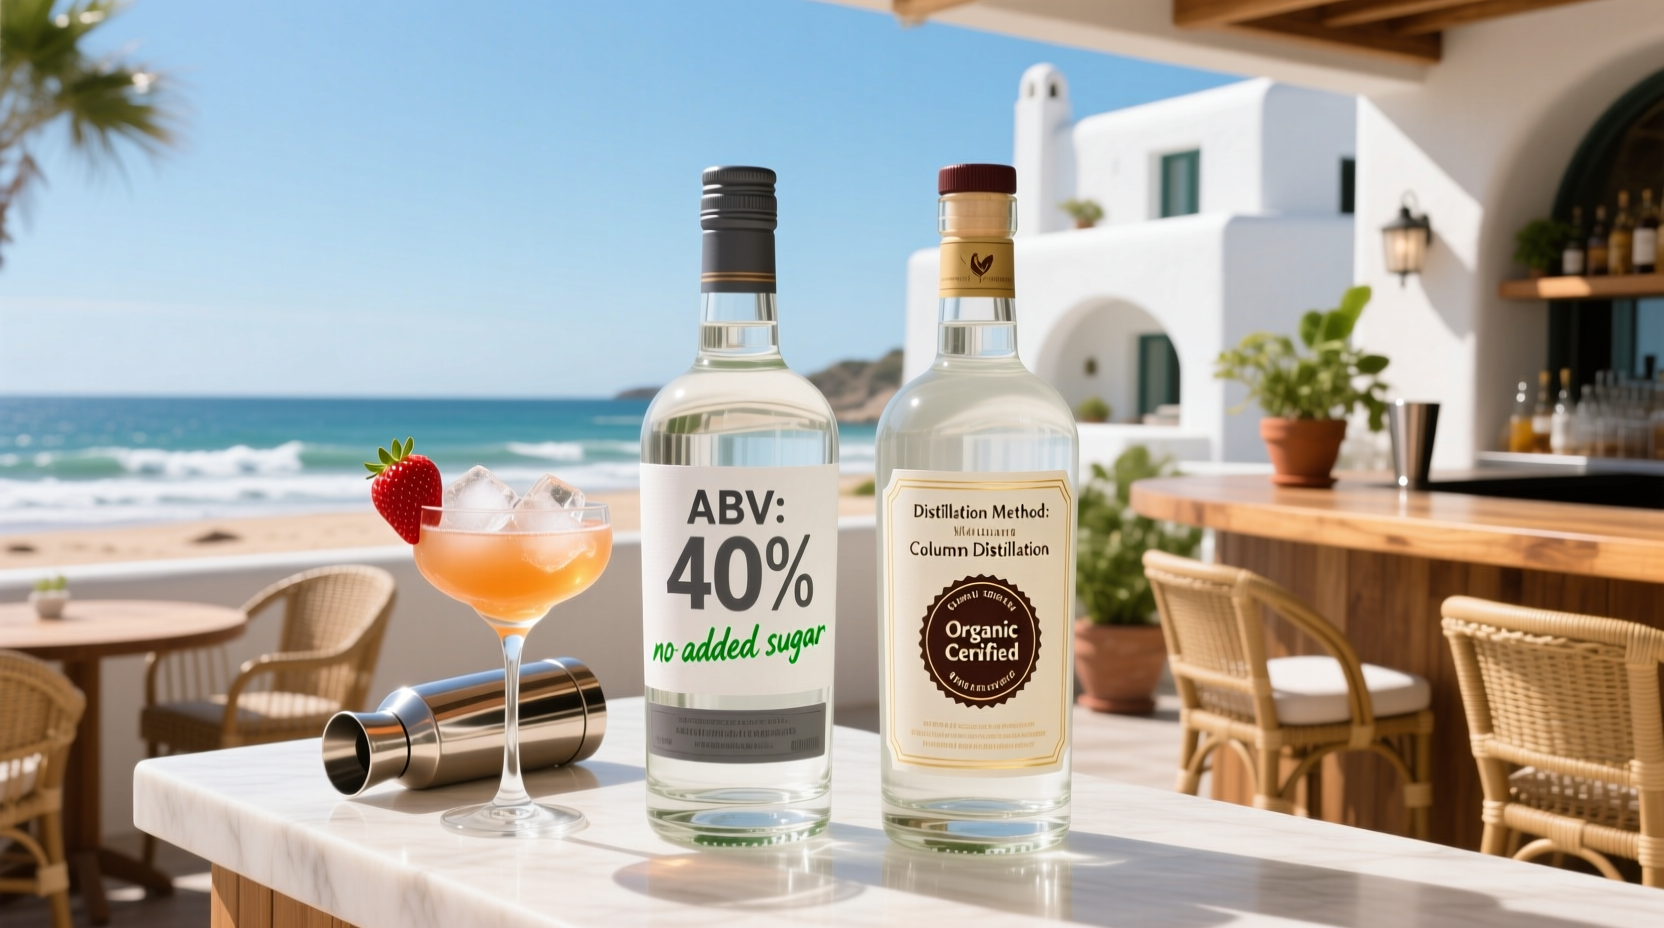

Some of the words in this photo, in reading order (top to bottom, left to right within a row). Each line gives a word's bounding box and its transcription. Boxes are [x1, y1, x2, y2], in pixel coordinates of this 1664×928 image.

[687, 489, 785, 525] ABV:
[914, 503, 987, 519] Distillation
[992, 502, 1049, 519] Method:
[909, 541, 968, 557] Column
[973, 541, 1049, 557] Distillation
[666, 534, 814, 612] 40%
[652, 641, 678, 663] no
[681, 623, 760, 663] added
[765, 624, 826, 665] sugar
[945, 620, 1018, 643] Organic
